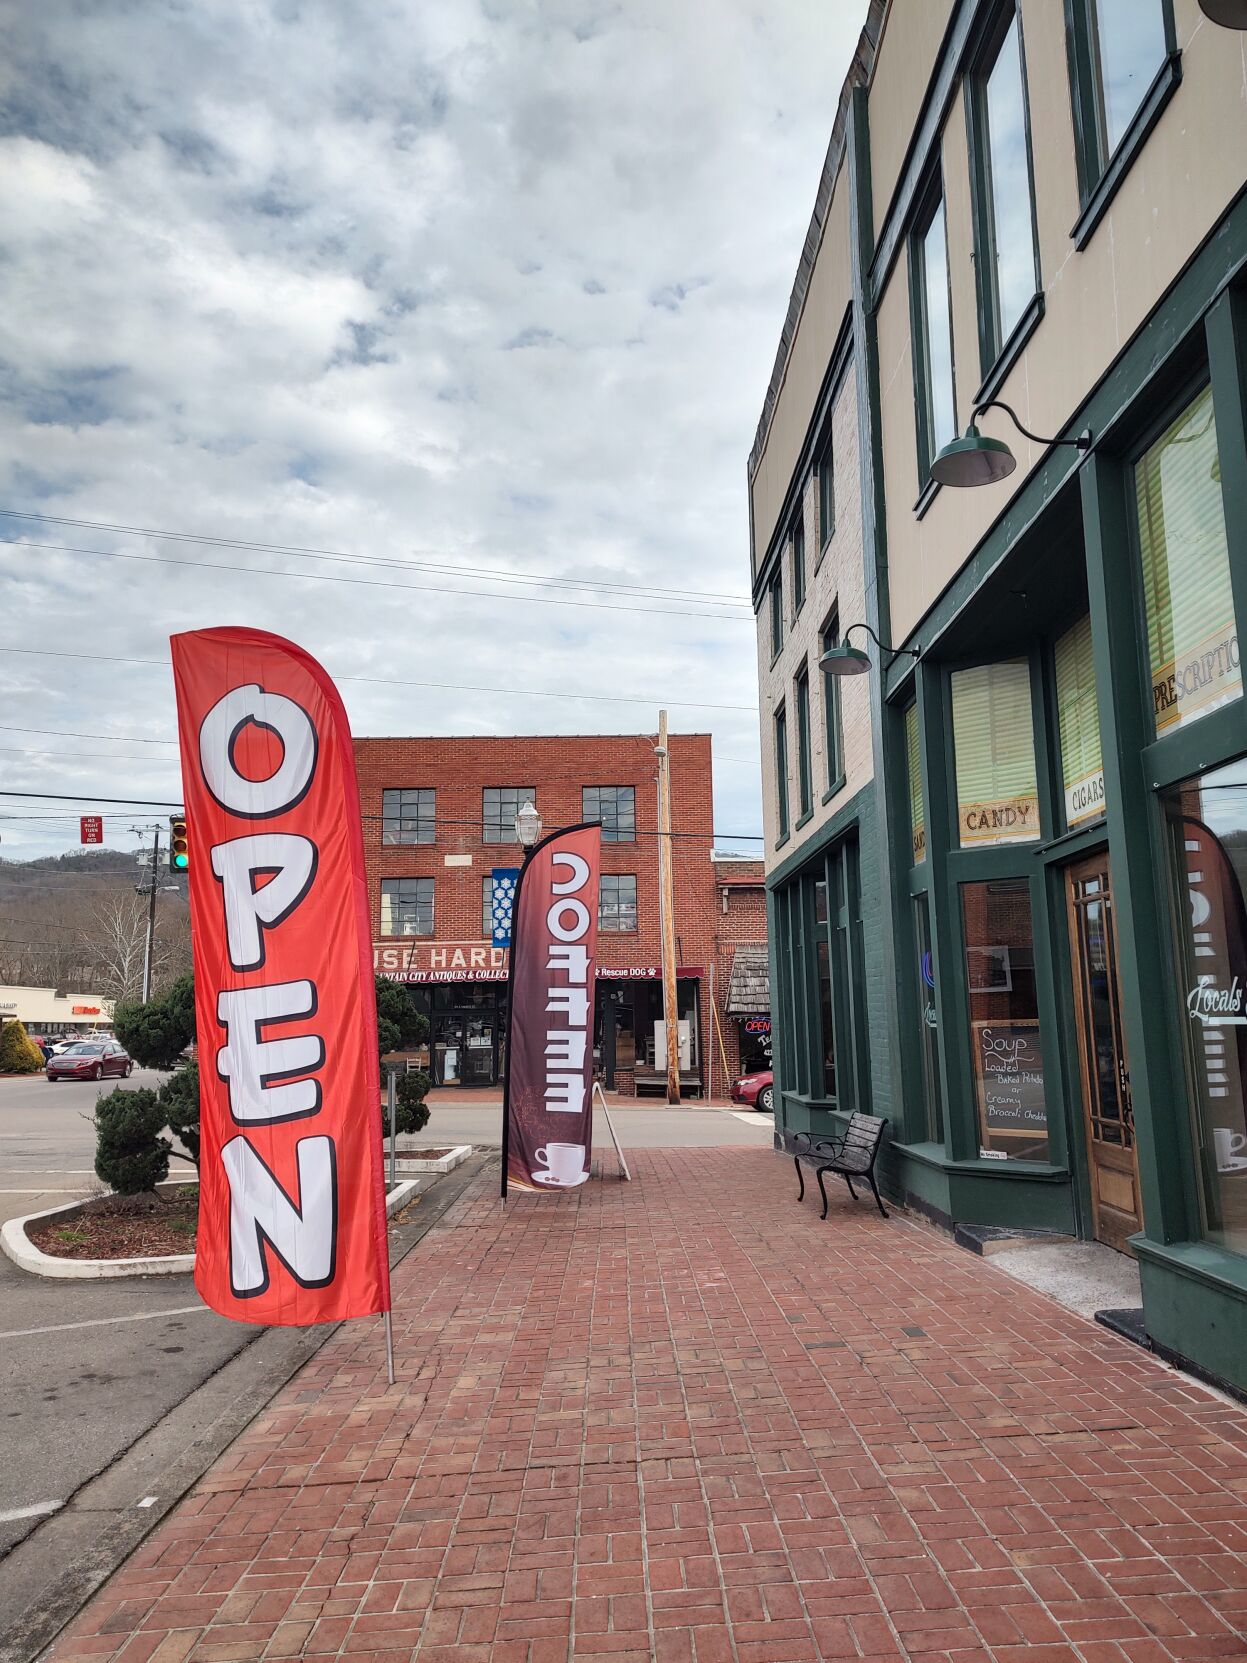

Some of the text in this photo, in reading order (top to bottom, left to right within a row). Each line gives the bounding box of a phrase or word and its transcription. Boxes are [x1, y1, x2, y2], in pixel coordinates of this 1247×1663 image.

[1153, 636, 1240, 714] PRESCRIPTIO
[1071, 777, 1104, 811] CIGARS
[966, 806, 1031, 831] CANDY
[409, 971, 428, 981] CITY
[428, 971, 467, 982] ANTIQUES
[467, 971, 474, 980] &
[601, 968, 647, 976] Rescue DOG
[199, 682, 338, 1299] OPEN
[1187, 976, 1243, 1021] Locals
[746, 1021, 770, 1031] OPEN
[982, 1028, 1027, 1060] Soup
[985, 1058, 1019, 1072] Loaded
[986, 1091, 1022, 1109] Creamy
